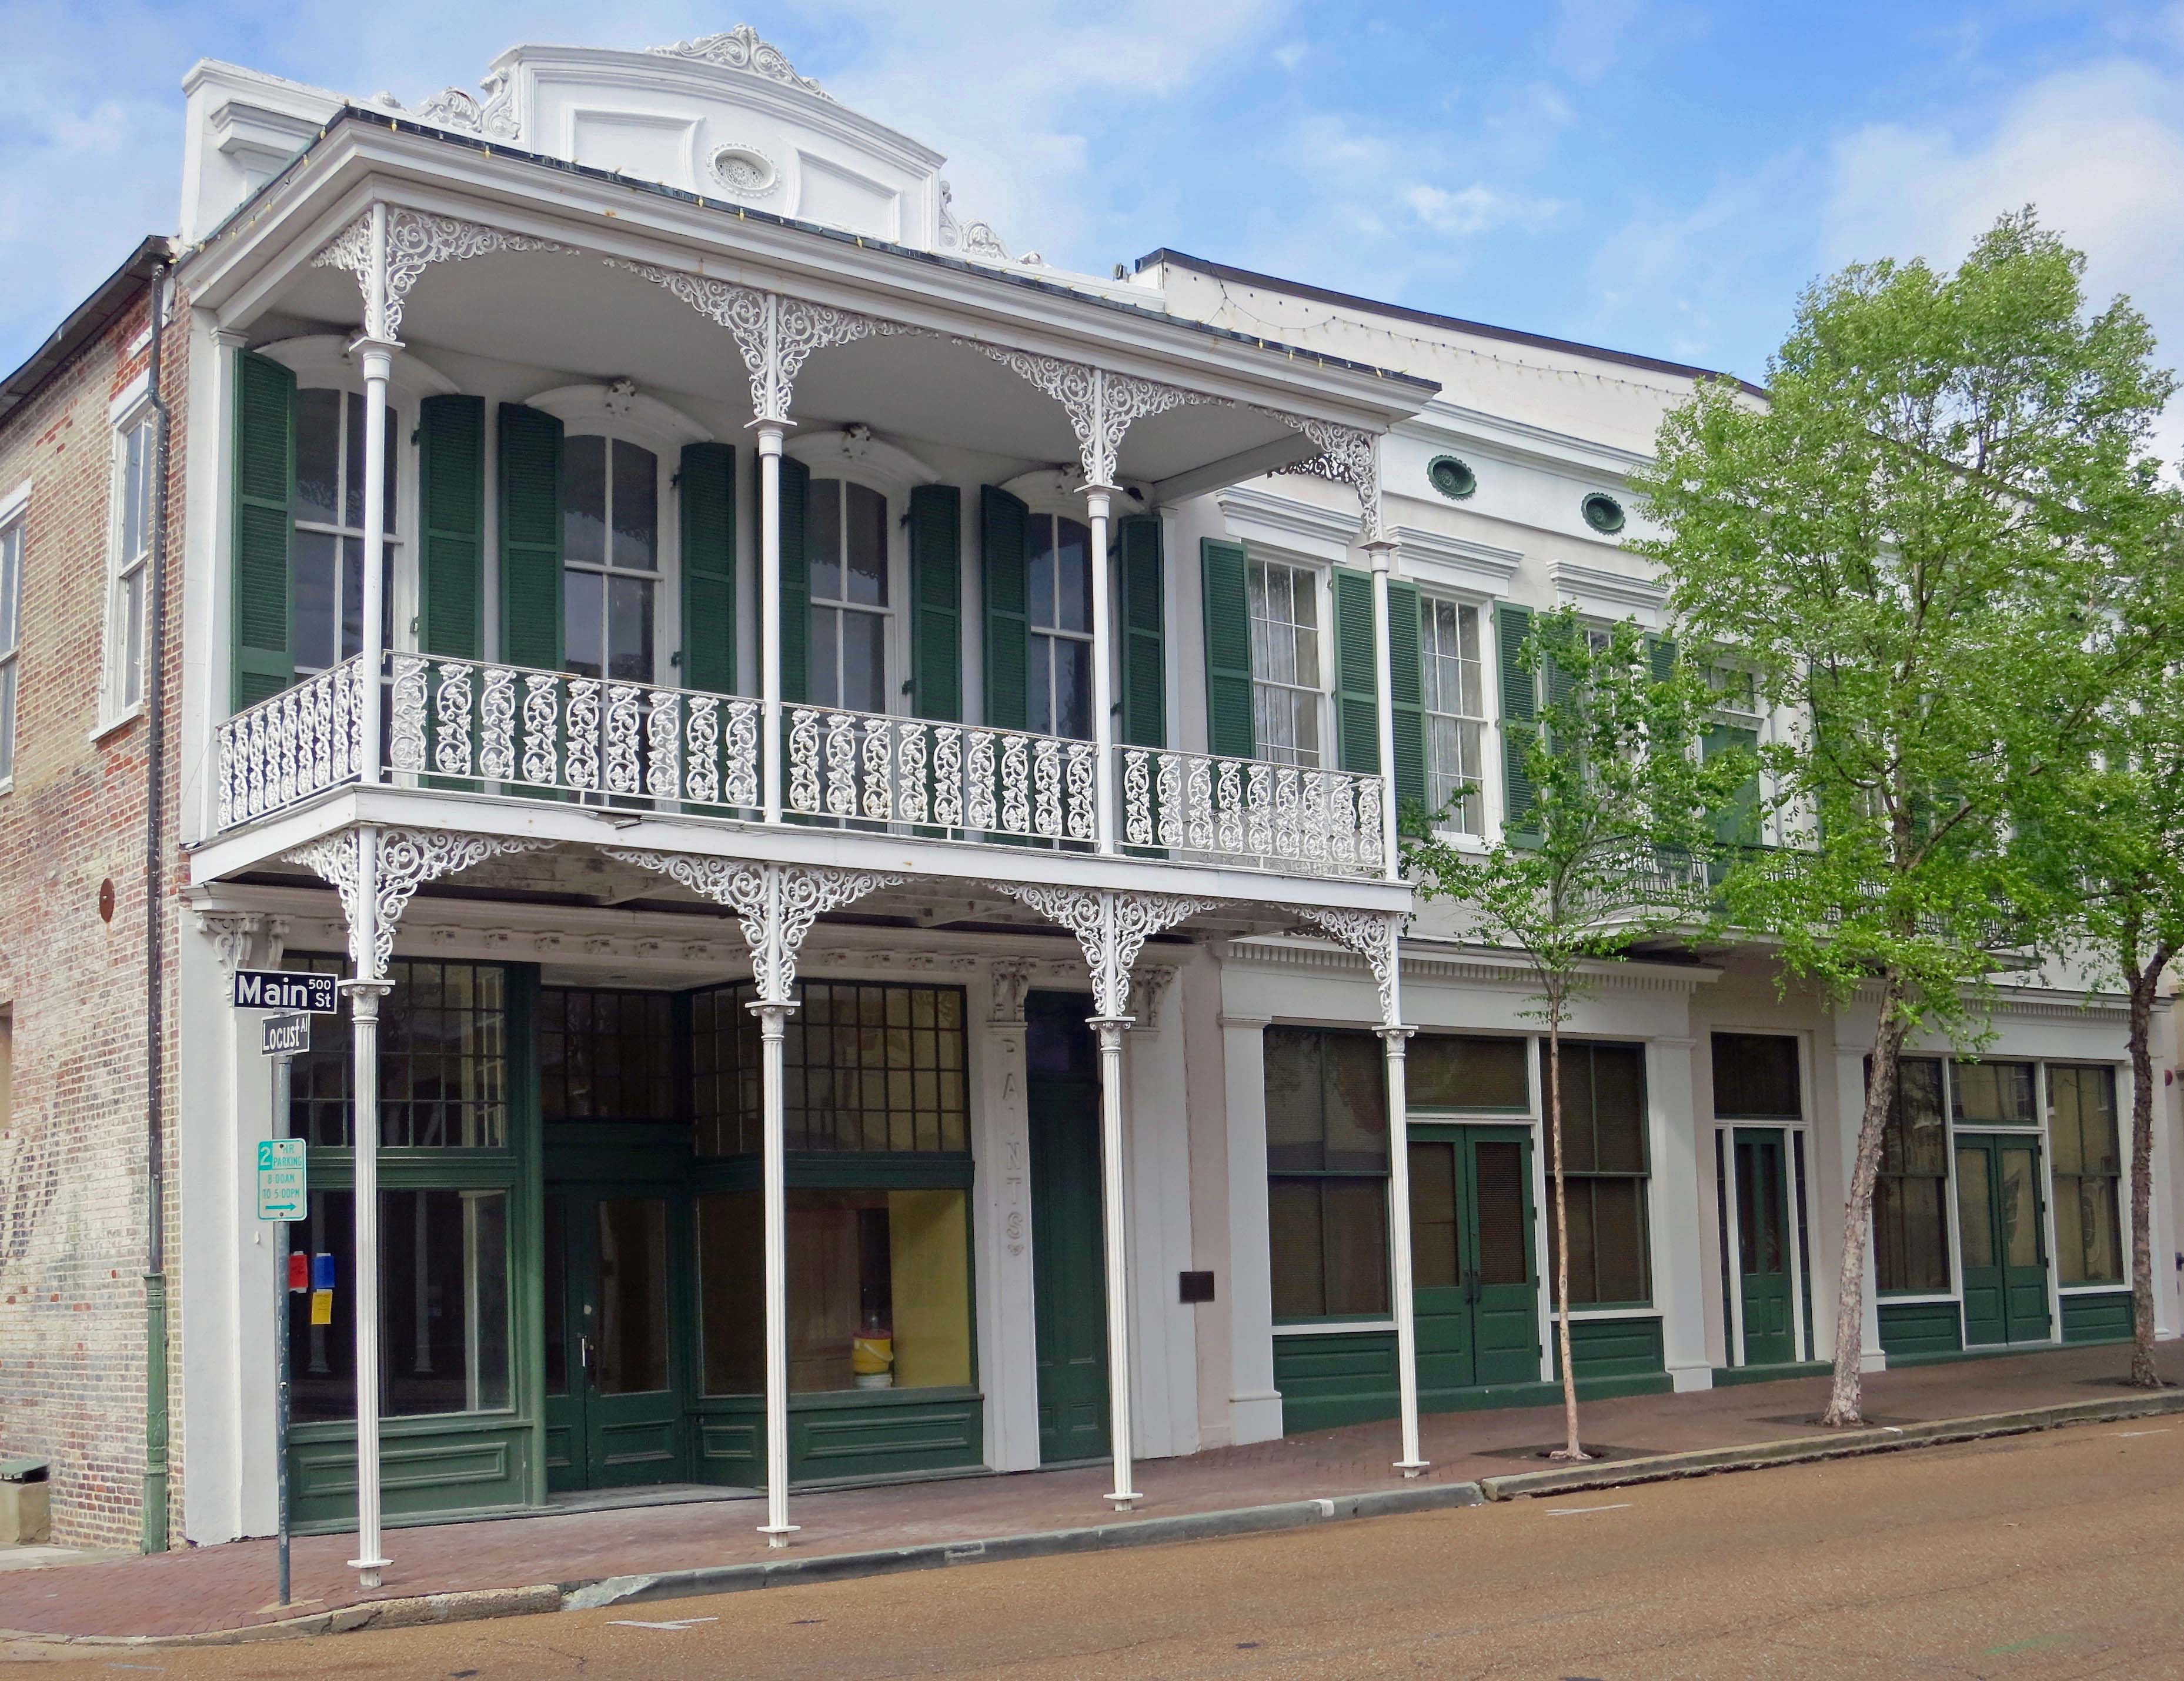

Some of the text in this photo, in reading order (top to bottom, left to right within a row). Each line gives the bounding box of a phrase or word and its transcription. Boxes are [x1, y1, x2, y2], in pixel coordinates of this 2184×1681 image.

[238, 975, 307, 1006] Main
[309, 979, 331, 990] 500
[315, 993, 331, 1008] St
[263, 1017, 308, 1050] Locust Al
[261, 1144, 295, 1166] 2 HR
[273, 1157, 302, 1166] PARKING
[268, 1173, 295, 1184] 8:00AM
[263, 1188, 300, 1199] TO 5:00PM
